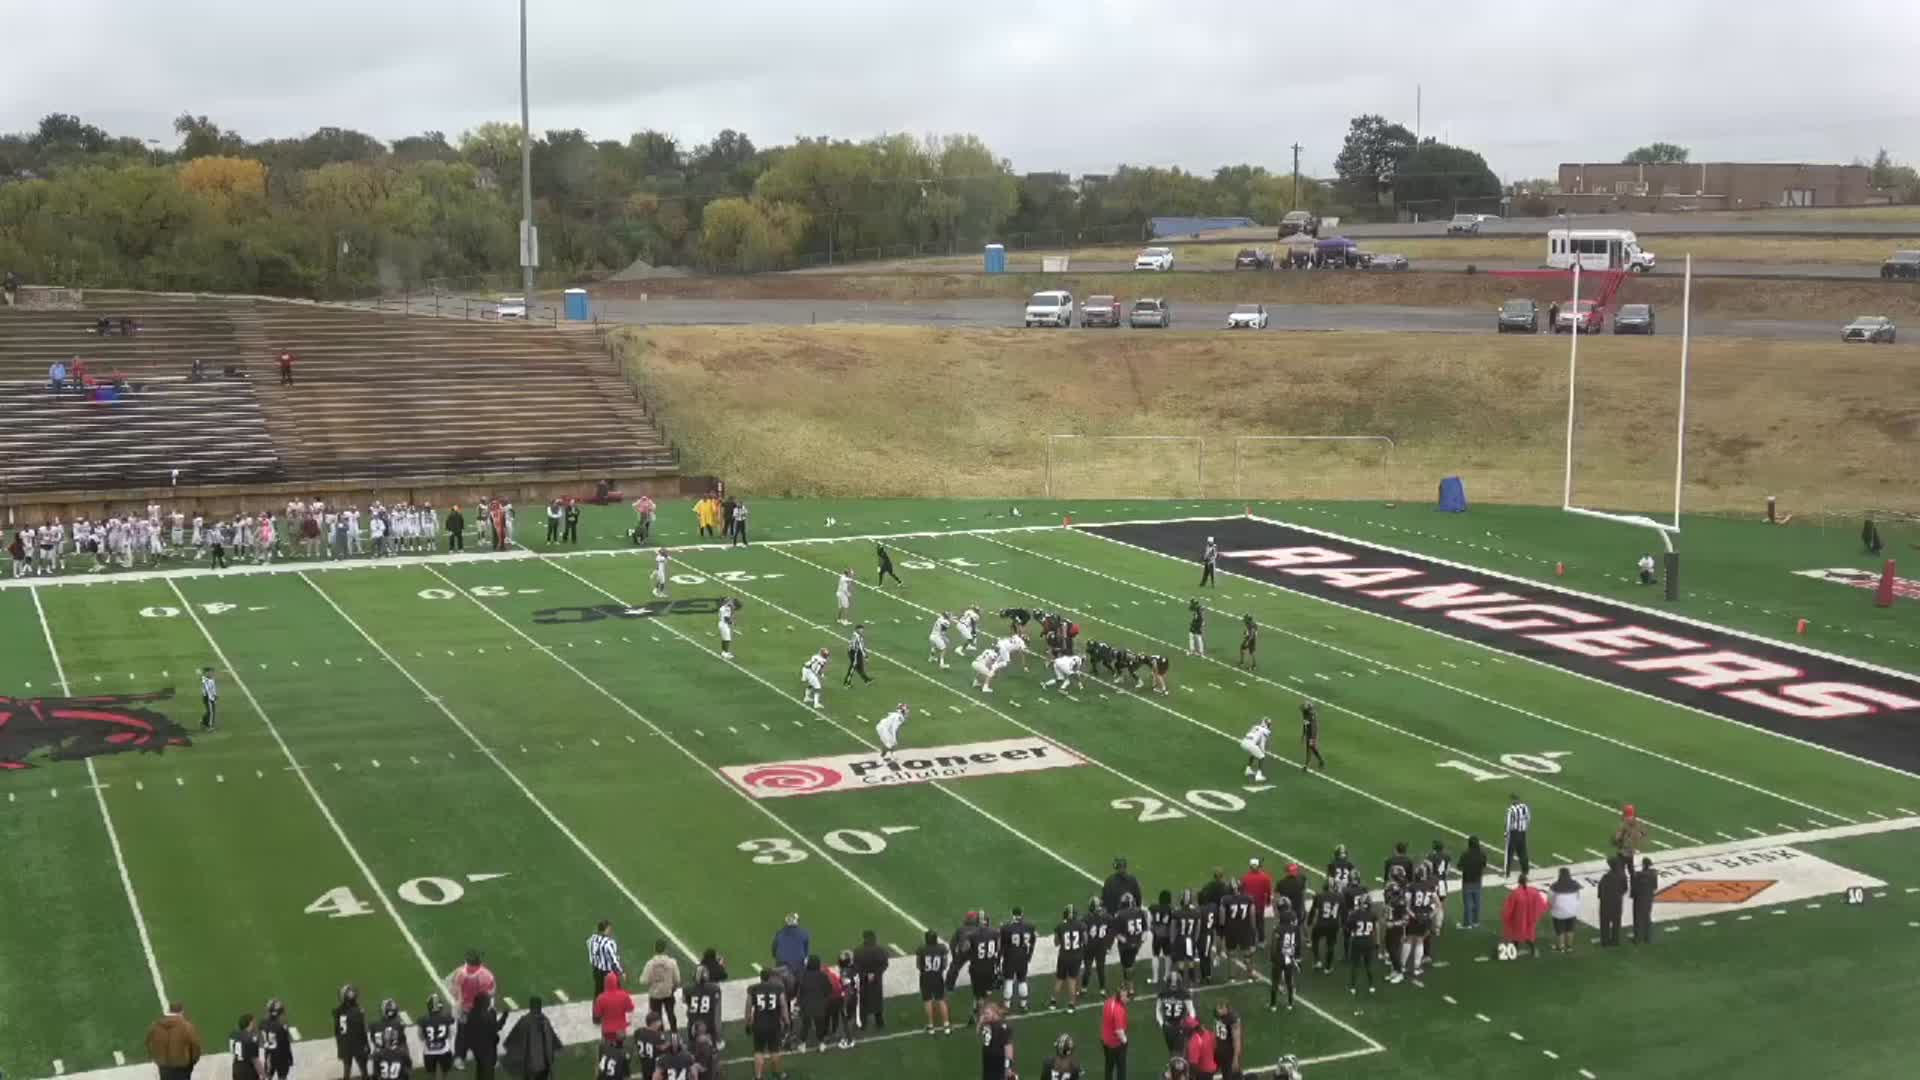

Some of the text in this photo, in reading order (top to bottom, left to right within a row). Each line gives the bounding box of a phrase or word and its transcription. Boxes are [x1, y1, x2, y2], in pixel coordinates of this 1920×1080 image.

[1221, 546, 1920, 720] RANGERS
[848, 746, 1049, 776] Pioneer
[1434, 752, 1562, 782] 10
[863, 768, 967, 785] Cellular
[1110, 789, 1247, 823] 20
[736, 829, 887, 864] 30
[304, 876, 464, 918] 40
[1848, 888, 1864, 904] 10
[1230, 904, 1248, 919] 77
[1497, 943, 1518, 960] 20
[756, 993, 777, 1011] 53
[1165, 1003, 1183, 1017] 25
